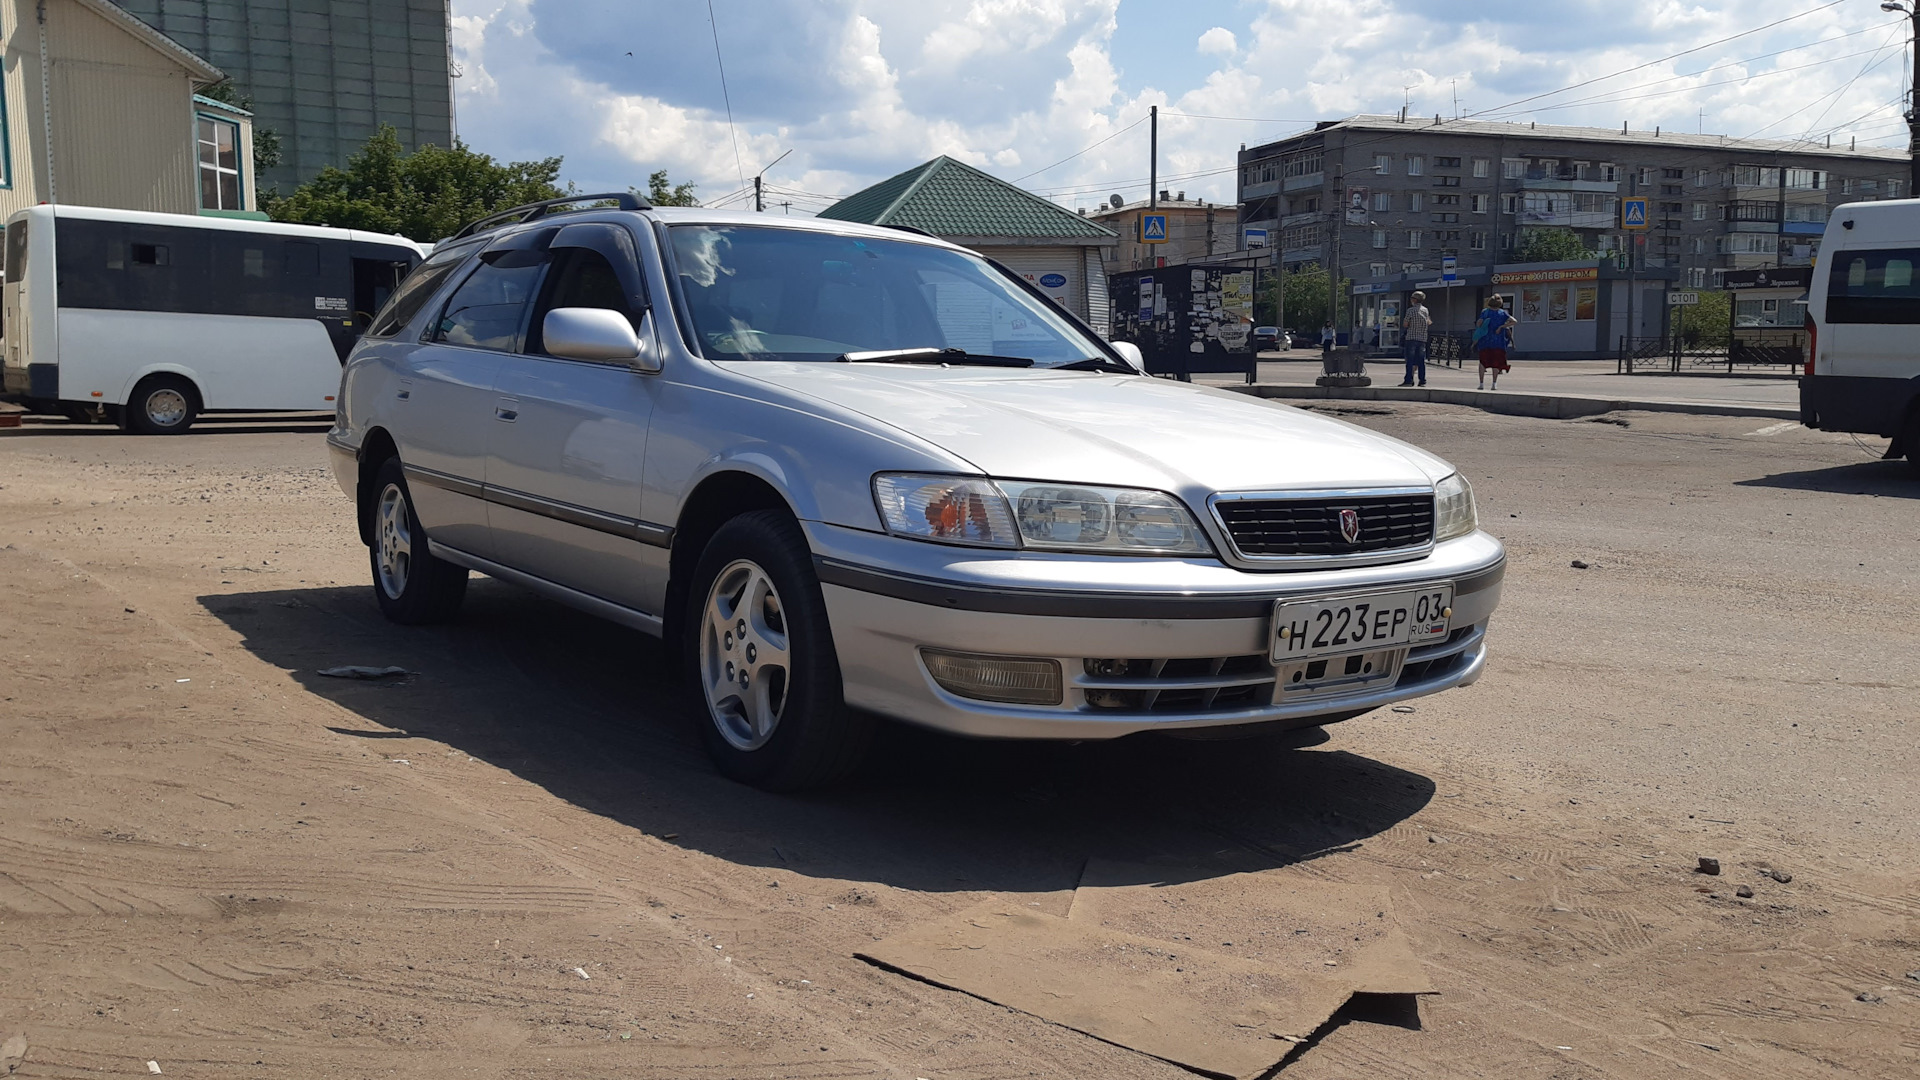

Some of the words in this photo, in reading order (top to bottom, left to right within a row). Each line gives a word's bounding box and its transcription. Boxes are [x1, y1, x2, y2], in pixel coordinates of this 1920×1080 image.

[1501, 273, 1531, 283] БУРЯТ
[1563, 270, 1591, 279] ПРОМ
[1671, 293, 1695, 303] СТОП
[1416, 593, 1443, 623] 03
[1410, 623, 1430, 636] RUS
